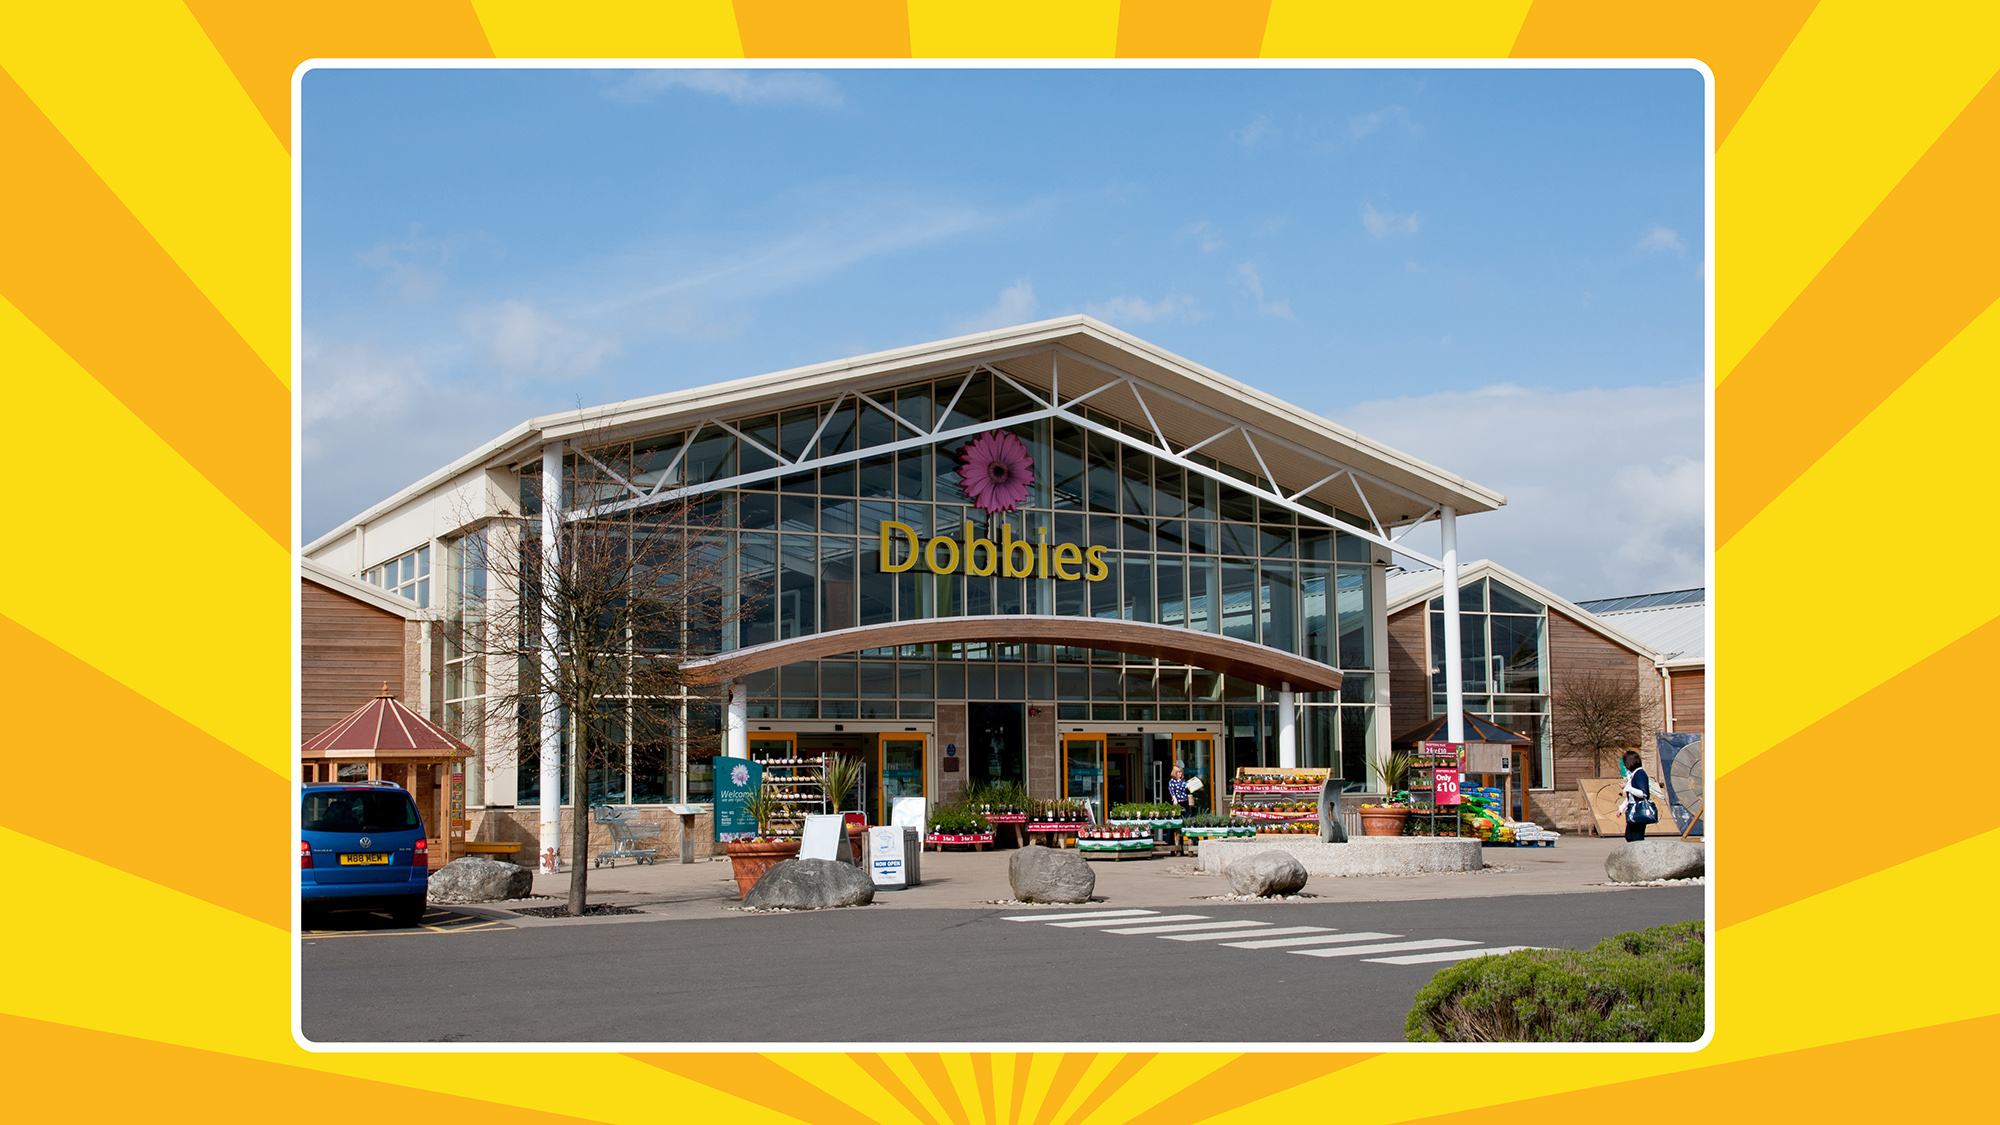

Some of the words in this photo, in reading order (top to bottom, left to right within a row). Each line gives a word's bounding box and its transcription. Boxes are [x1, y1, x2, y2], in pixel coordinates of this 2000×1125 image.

[880, 520, 1109, 581] Dobbies
[1436, 774, 1451, 782] Only
[1437, 782, 1456, 792] £10
[721, 789, 753, 798] Welcome
